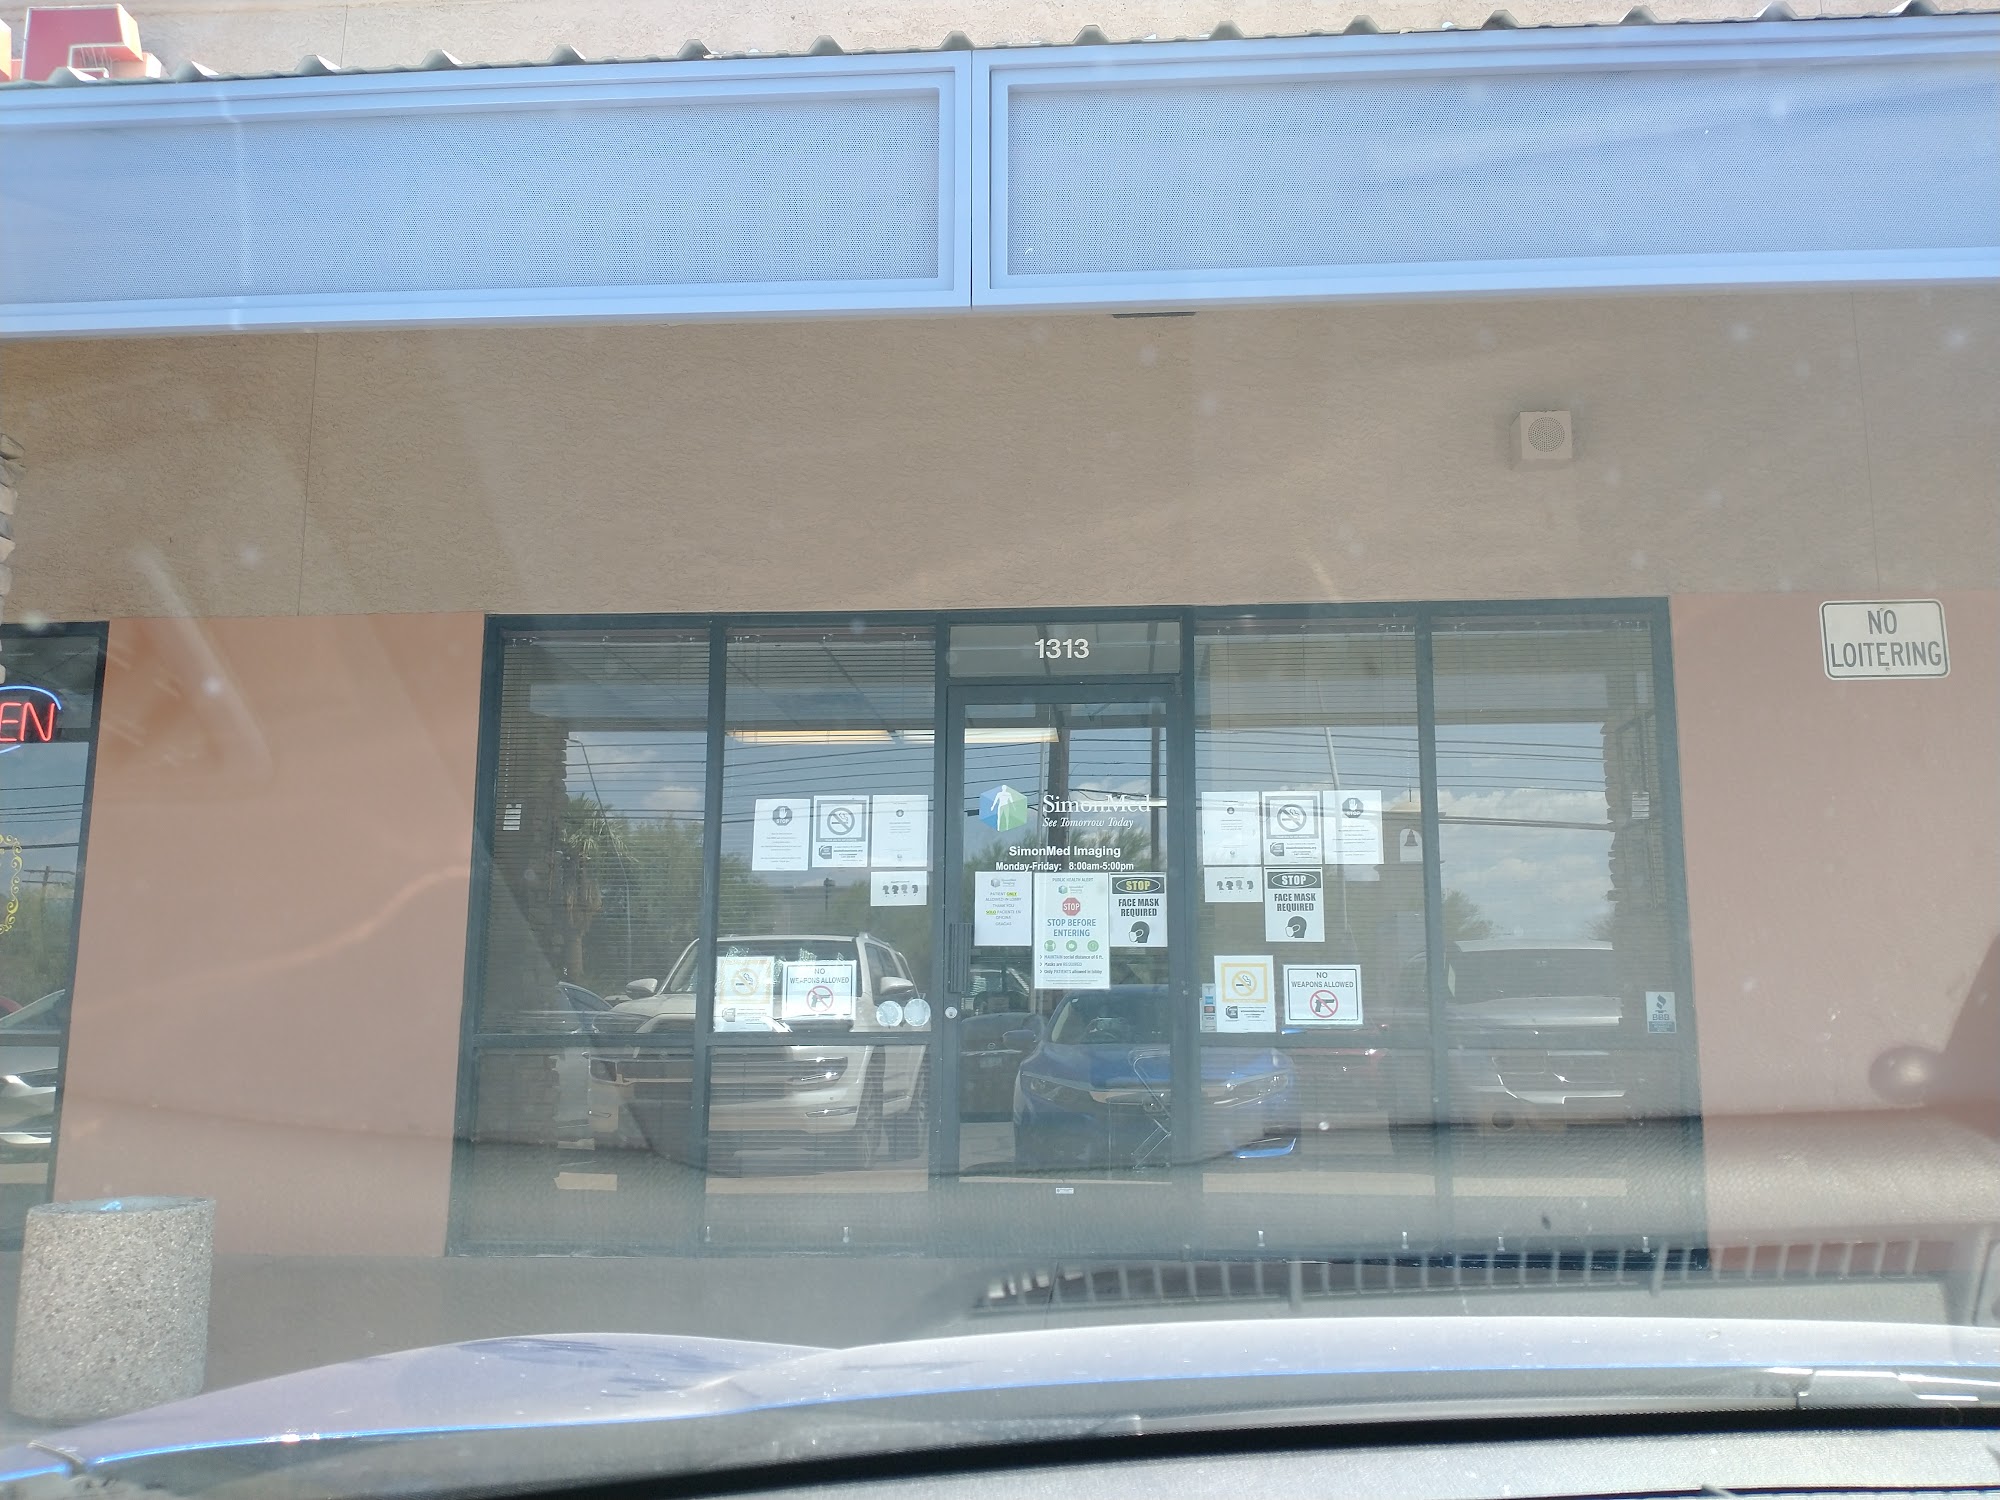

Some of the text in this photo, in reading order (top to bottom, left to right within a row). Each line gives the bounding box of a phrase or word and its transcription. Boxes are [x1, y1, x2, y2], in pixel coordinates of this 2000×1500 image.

[1867, 609, 1897, 635] NO
[1034, 638, 1090, 659] 1313
[1830, 641, 1941, 667] LOITERING
[1042, 794, 1151, 813] SimonMed
[1042, 817, 1134, 829] See Tomorrow Today
[1009, 845, 1121, 858] SimonMed Imaging
[995, 861, 1134, 873] Monday-Friday: 8:00am-5:00pm
[1281, 875, 1307, 885] STOP
[1125, 880, 1151, 891] STOP
[1118, 898, 1160, 907] FACE MASK
[1274, 893, 1316, 902] FACE MASK
[1063, 902, 1080, 911] STOP
[1276, 902, 1314, 912] REQUIRED
[1120, 908, 1157, 917] REQUIRED
[1047, 918, 1096, 927] STOP BEFORE
[1053, 929, 1091, 937] ENTERING
[814, 967, 826, 975] NO
[1316, 971, 1328, 979] NO
[820, 976, 850, 984] ALLOWED
